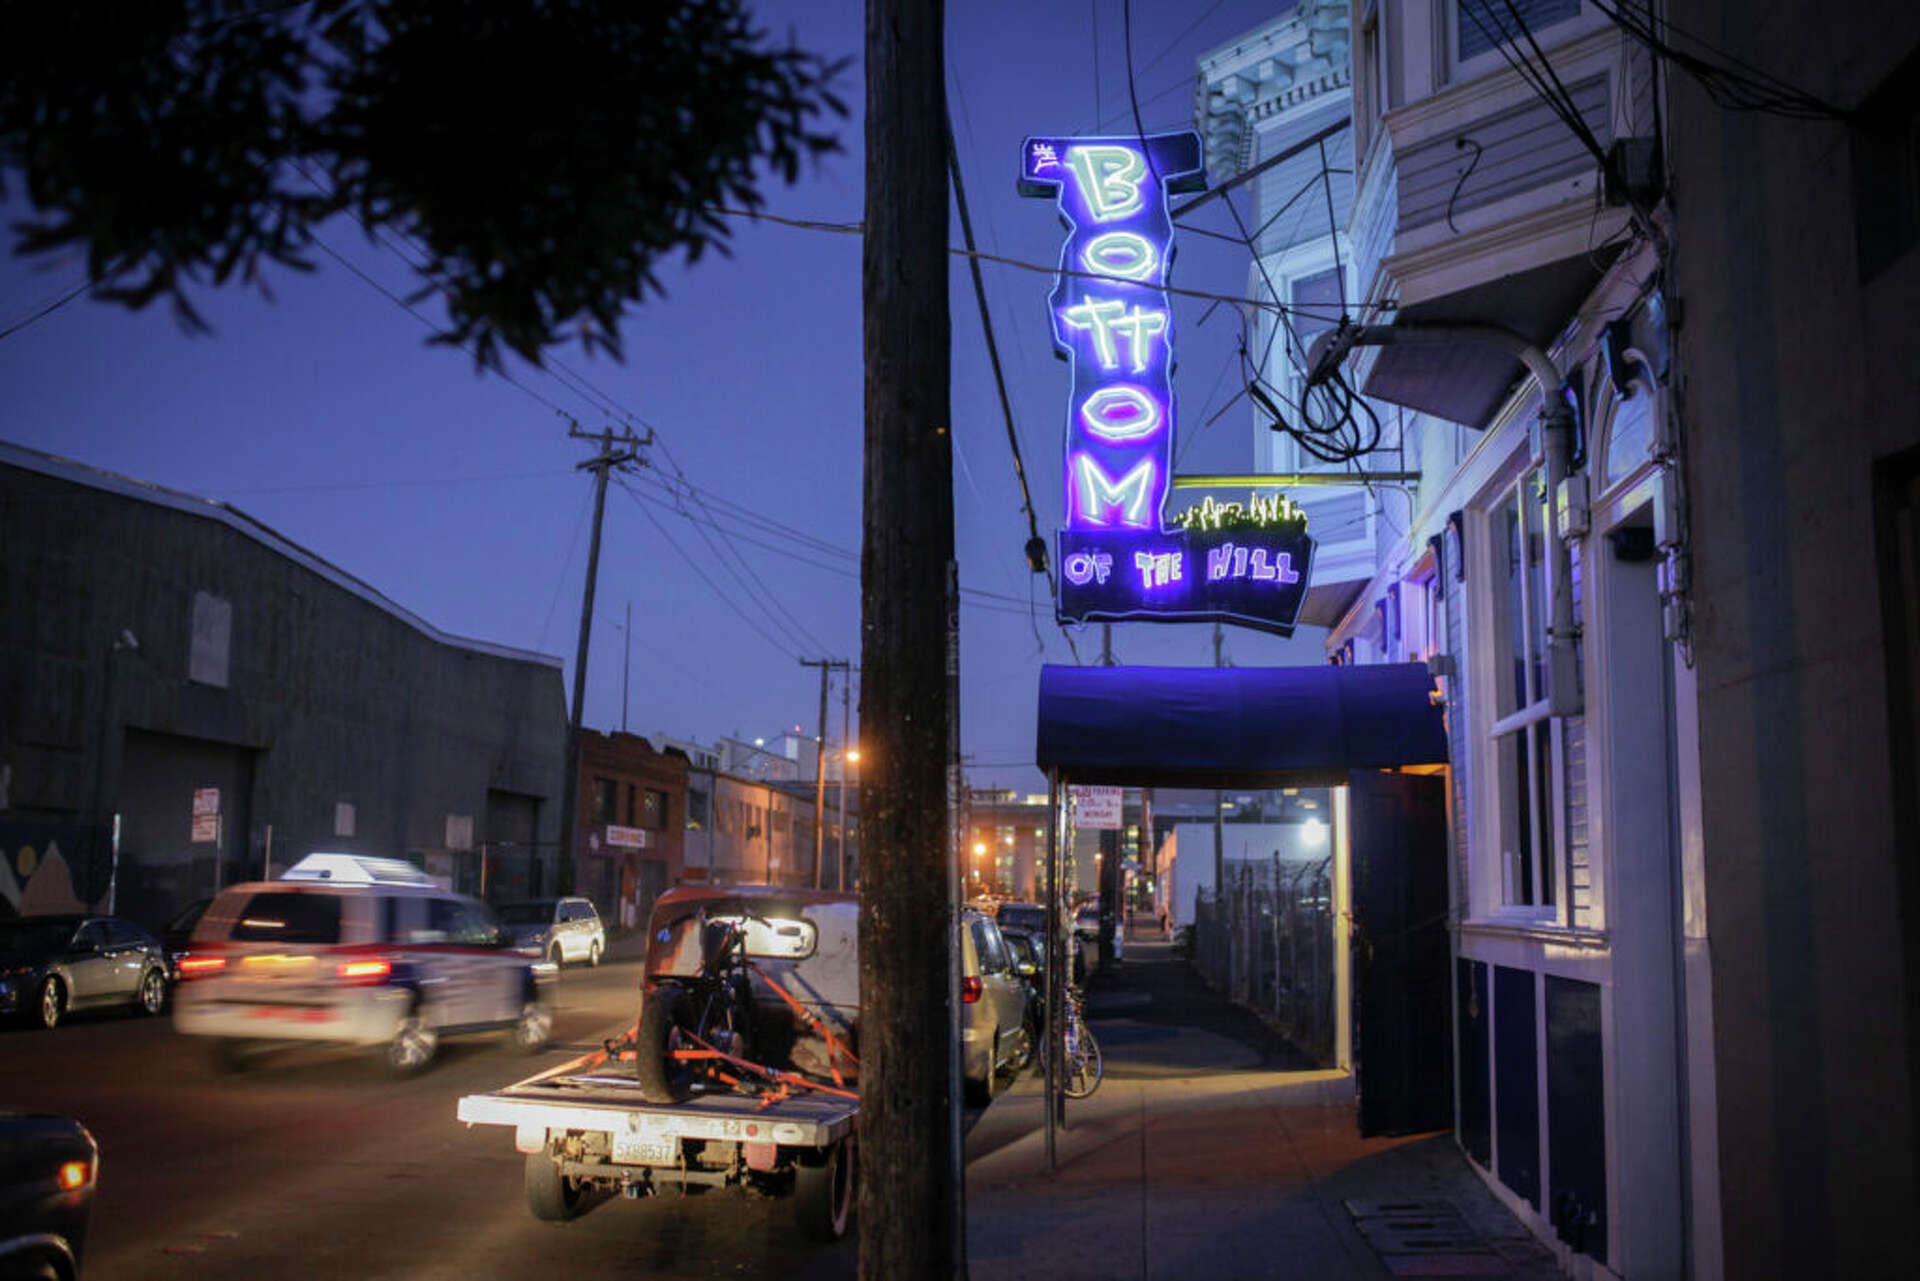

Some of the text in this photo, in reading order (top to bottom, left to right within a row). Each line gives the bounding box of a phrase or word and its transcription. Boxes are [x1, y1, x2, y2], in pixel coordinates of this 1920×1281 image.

[1065, 543, 1300, 587] OF THE HILL
